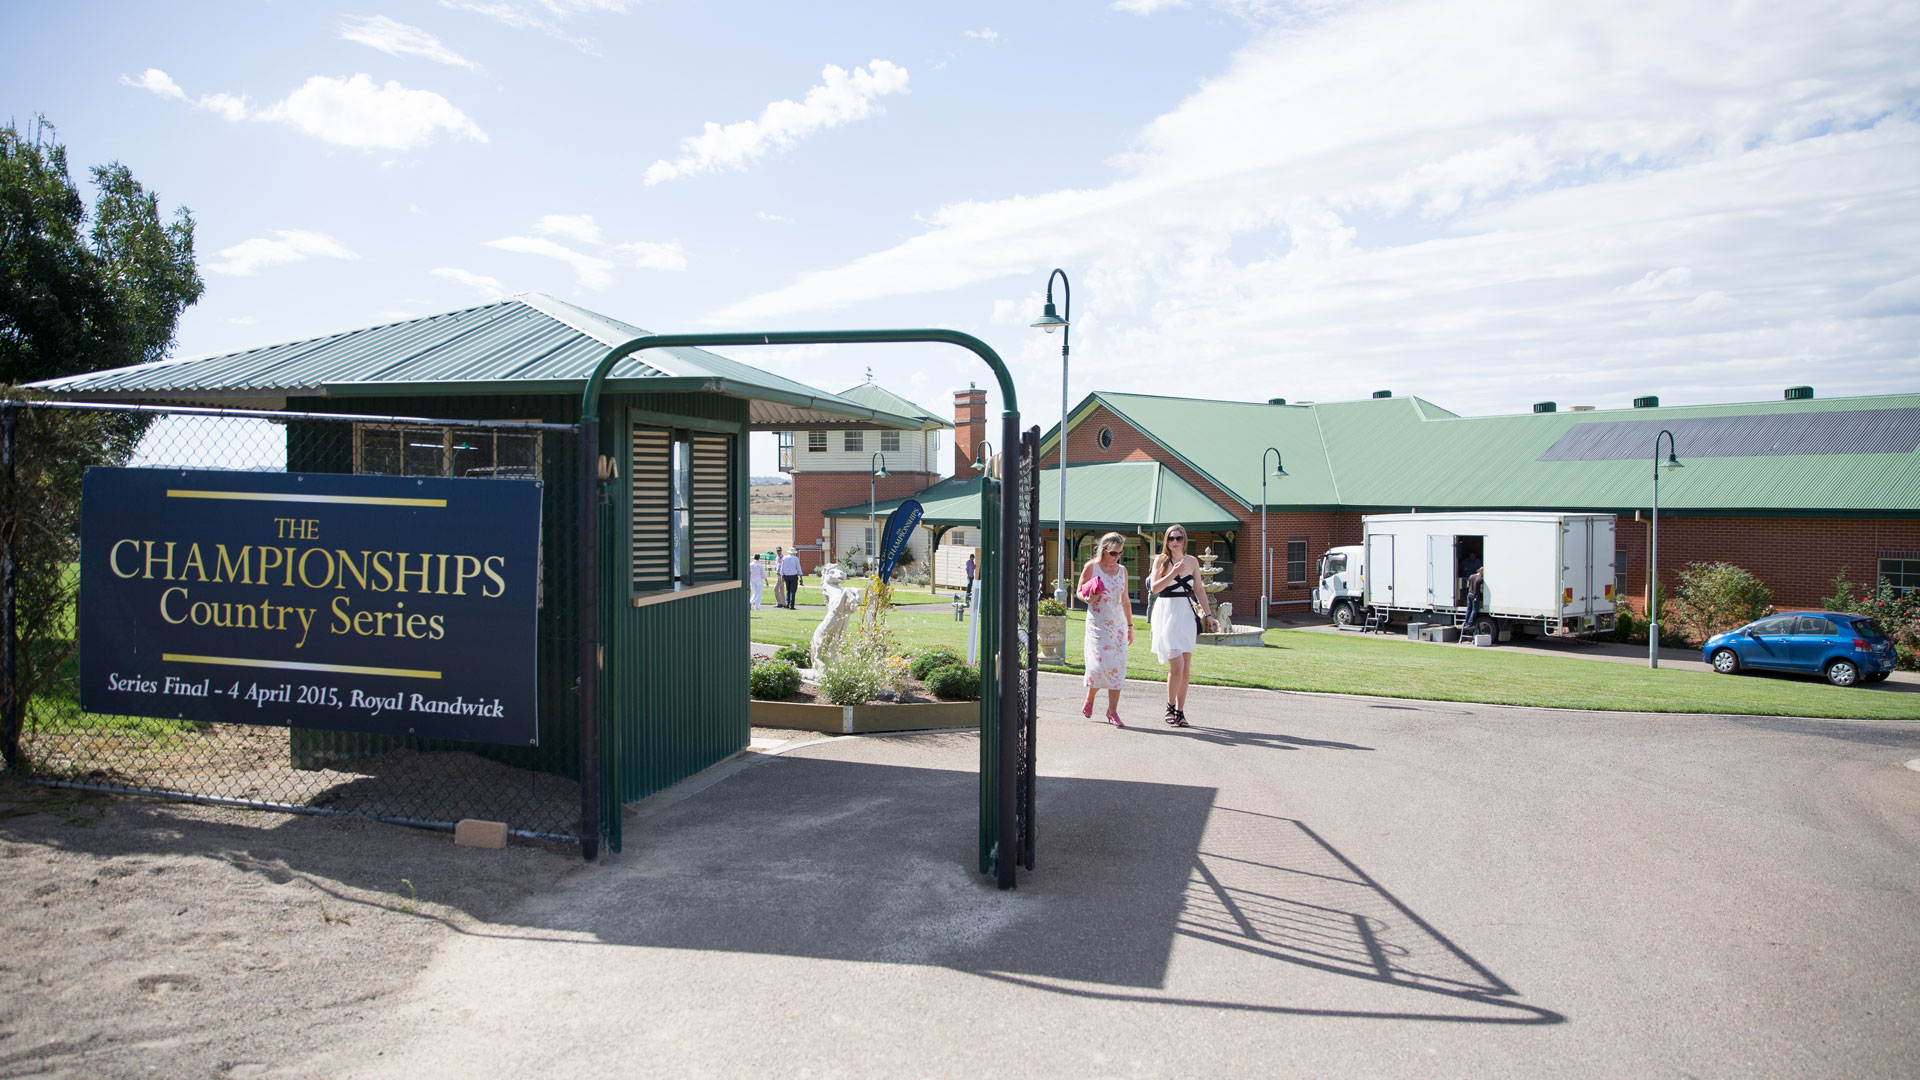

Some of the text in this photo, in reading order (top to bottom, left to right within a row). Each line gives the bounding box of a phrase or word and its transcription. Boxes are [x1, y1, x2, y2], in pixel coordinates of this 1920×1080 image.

[274, 518, 320, 540] THE
[887, 508, 920, 560] CHAMPIONSHIPS
[109, 539, 506, 598] CHAMPIONSHIPS
[160, 587, 445, 649] Country Series
[107, 673, 158, 694] Series
[163, 677, 209, 697] Final
[227, 682, 240, 700] 4
[244, 682, 291, 708] April
[297, 686, 343, 710] 2015,
[349, 690, 403, 716] Royal
[409, 694, 505, 719] Randwick
